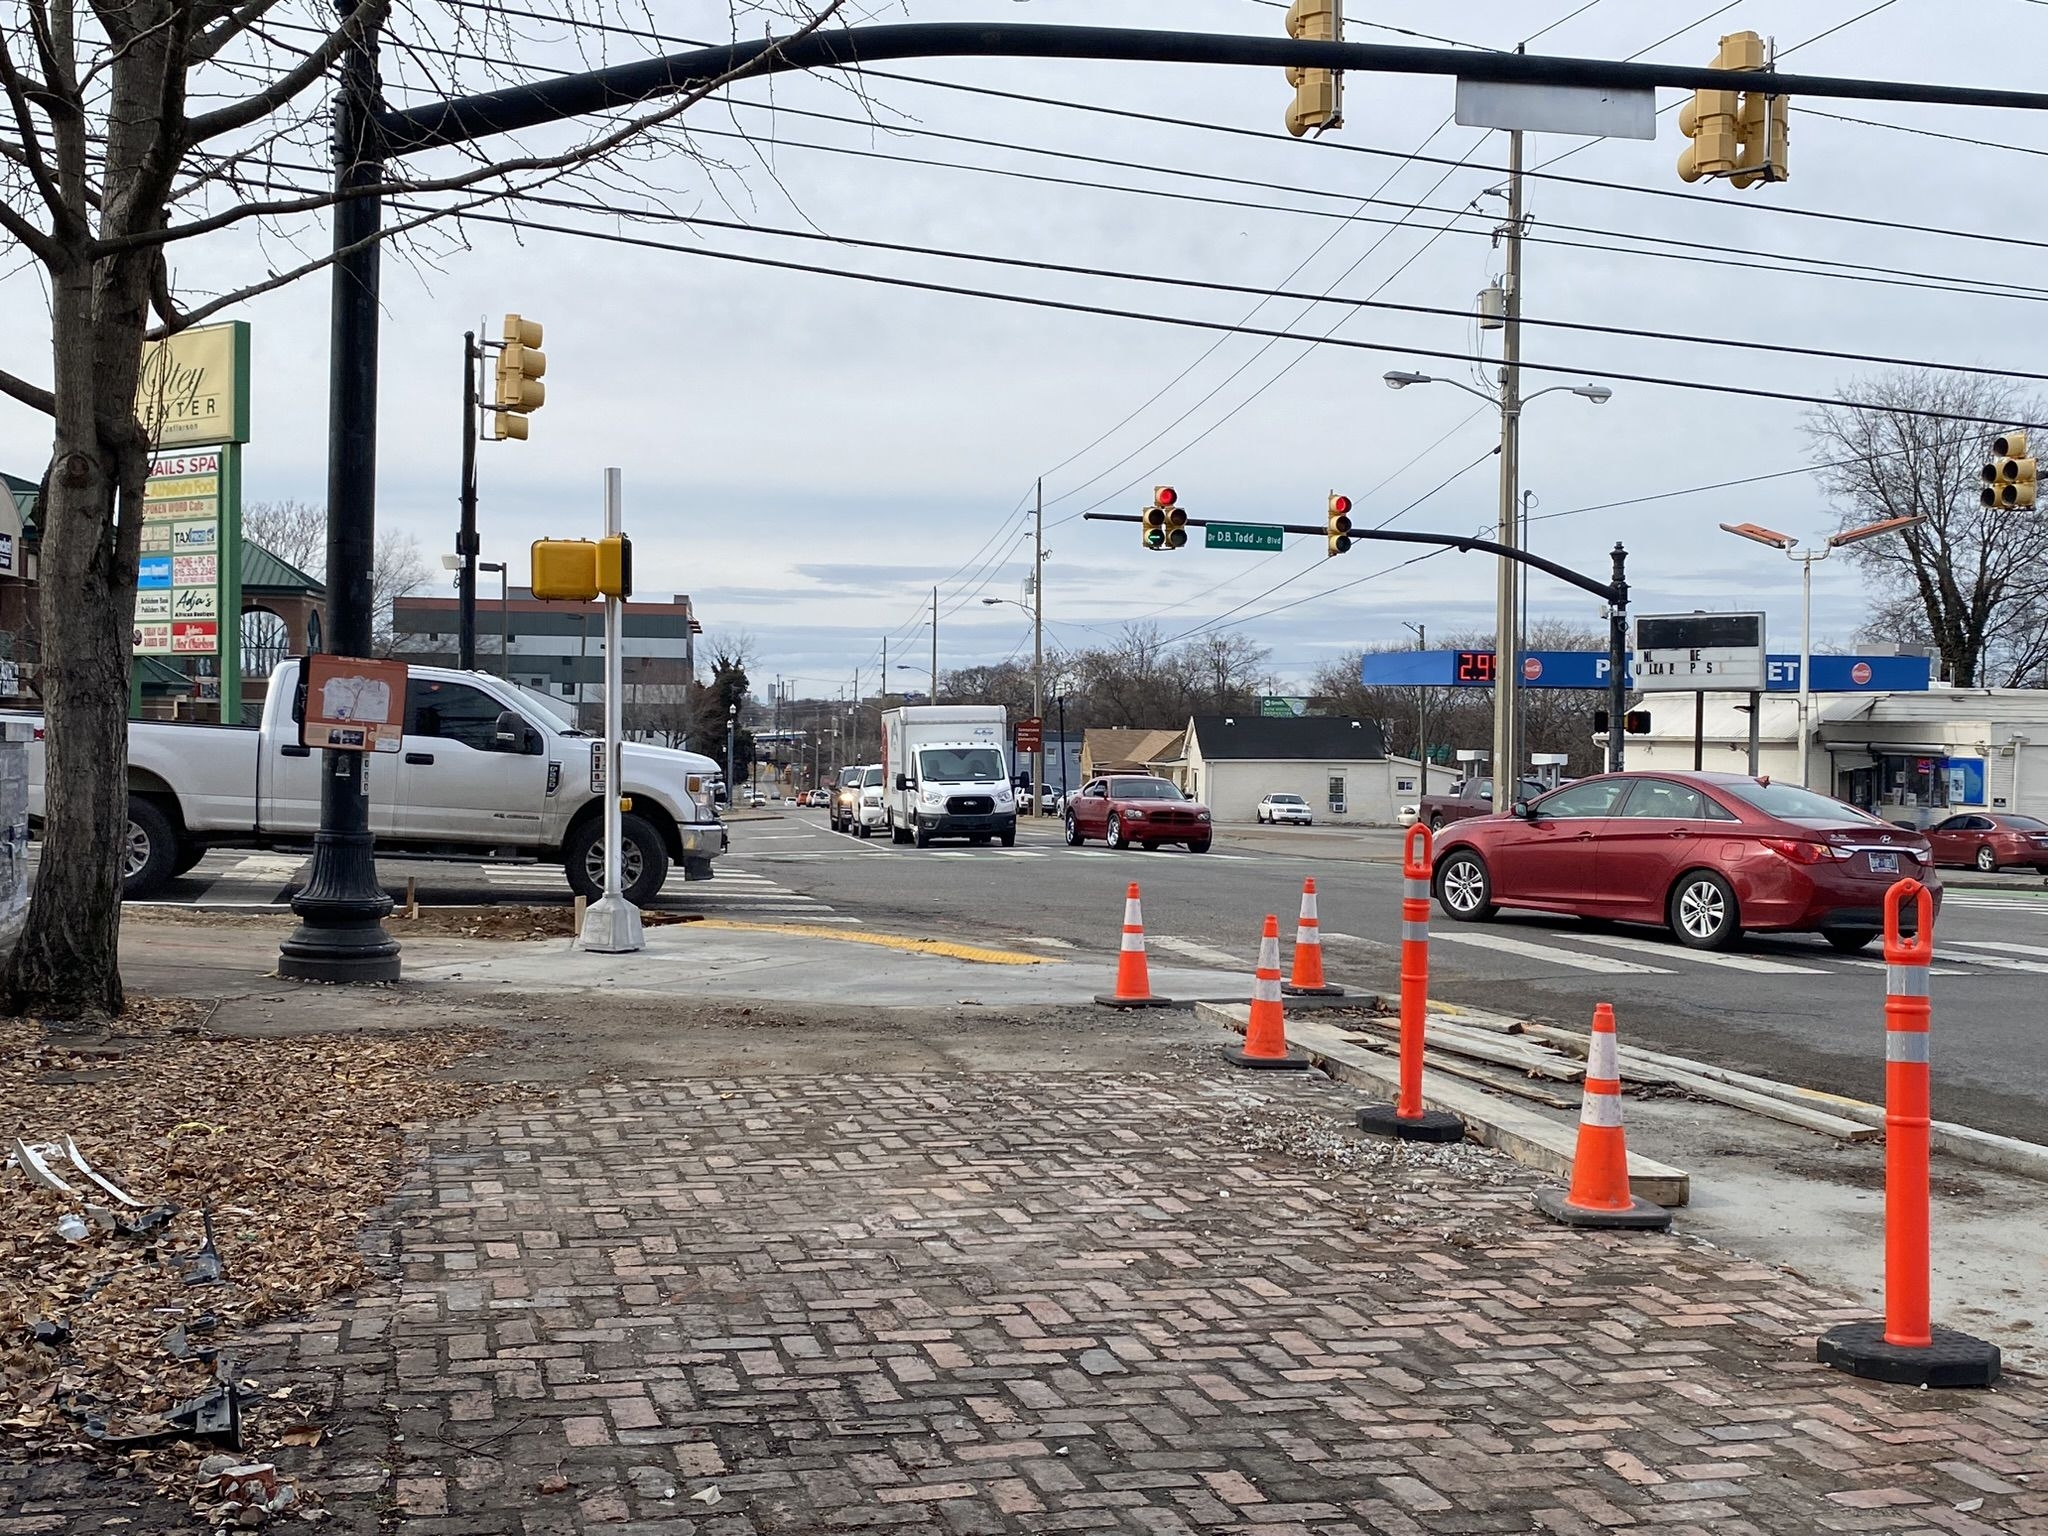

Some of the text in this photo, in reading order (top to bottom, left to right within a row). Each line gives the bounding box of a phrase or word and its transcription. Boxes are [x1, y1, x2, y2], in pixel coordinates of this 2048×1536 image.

[142, 342, 206, 414] Otey
[136, 398, 216, 422] ENTER
[189, 455, 218, 473] SPA
[1208, 531, 1281, 544] Dr D.B. Todd Jr Blvd
